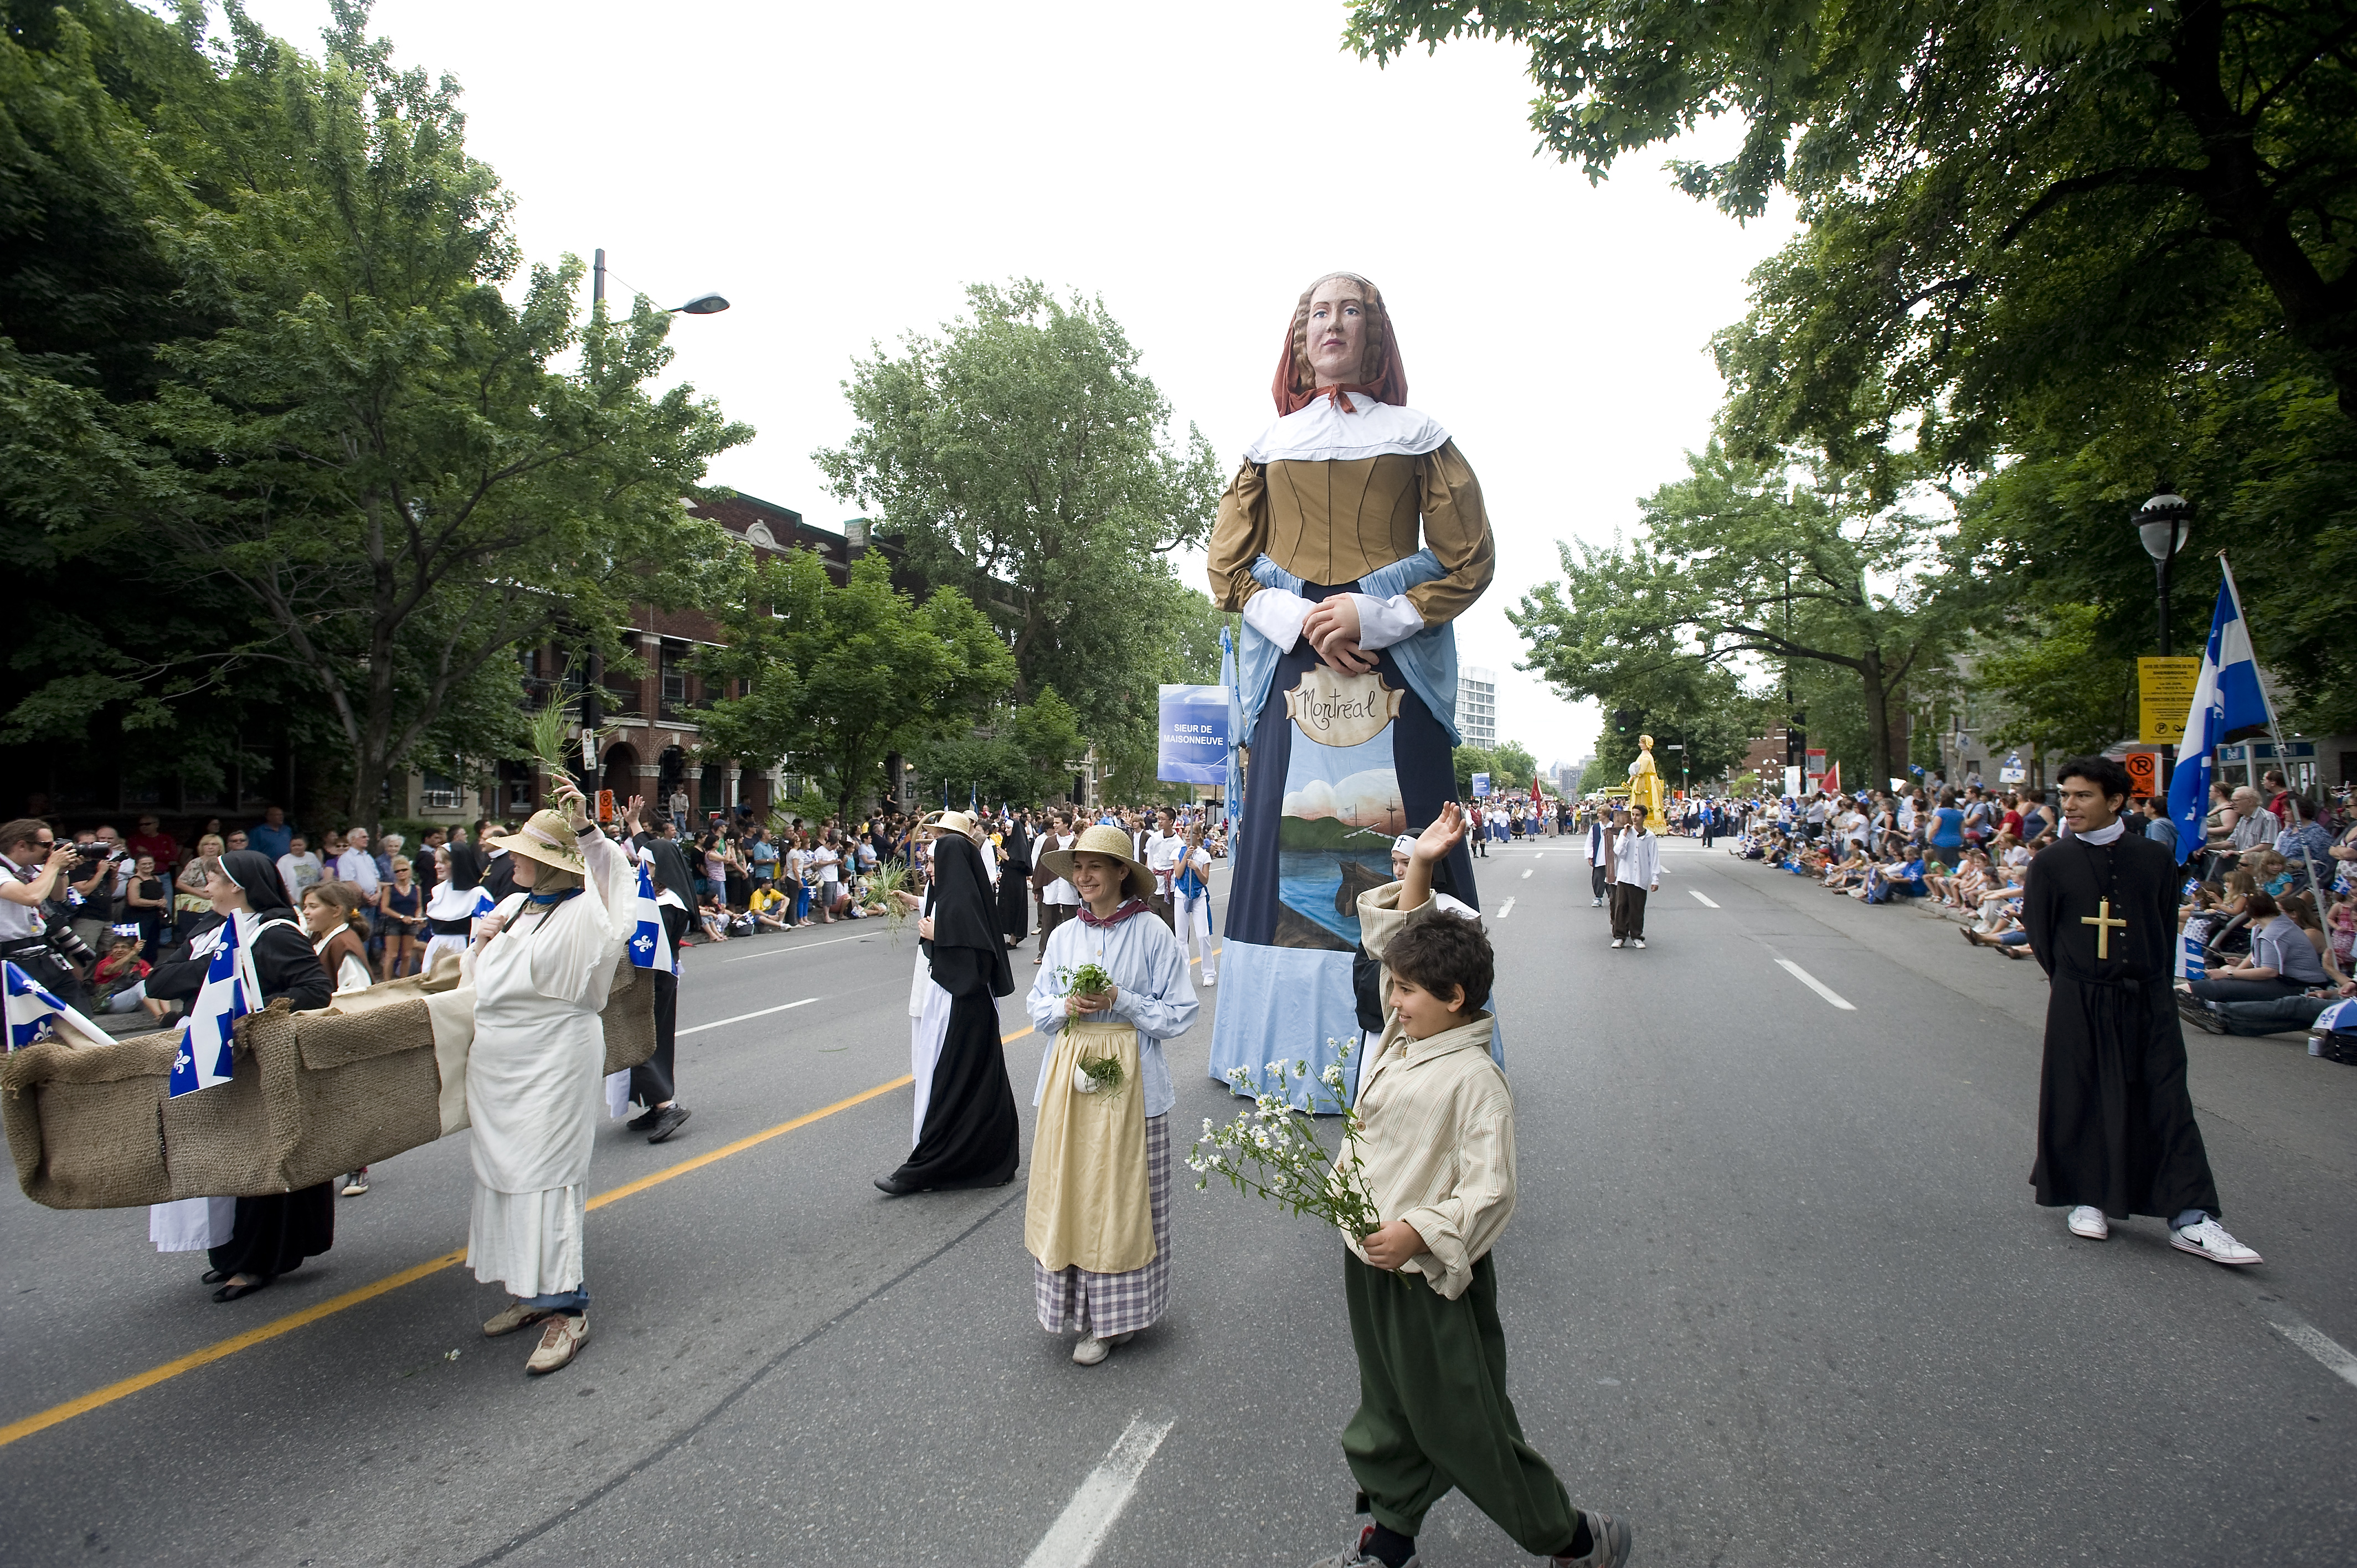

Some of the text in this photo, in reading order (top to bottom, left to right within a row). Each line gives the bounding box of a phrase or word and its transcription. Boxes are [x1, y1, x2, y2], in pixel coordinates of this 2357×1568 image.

[1296, 688, 1376, 731] Montréal
[1174, 724, 1212, 734] SIEUR DE
[1164, 735, 1223, 746] MAISONNEUVE
[2227, 747, 2239, 760] Bell
